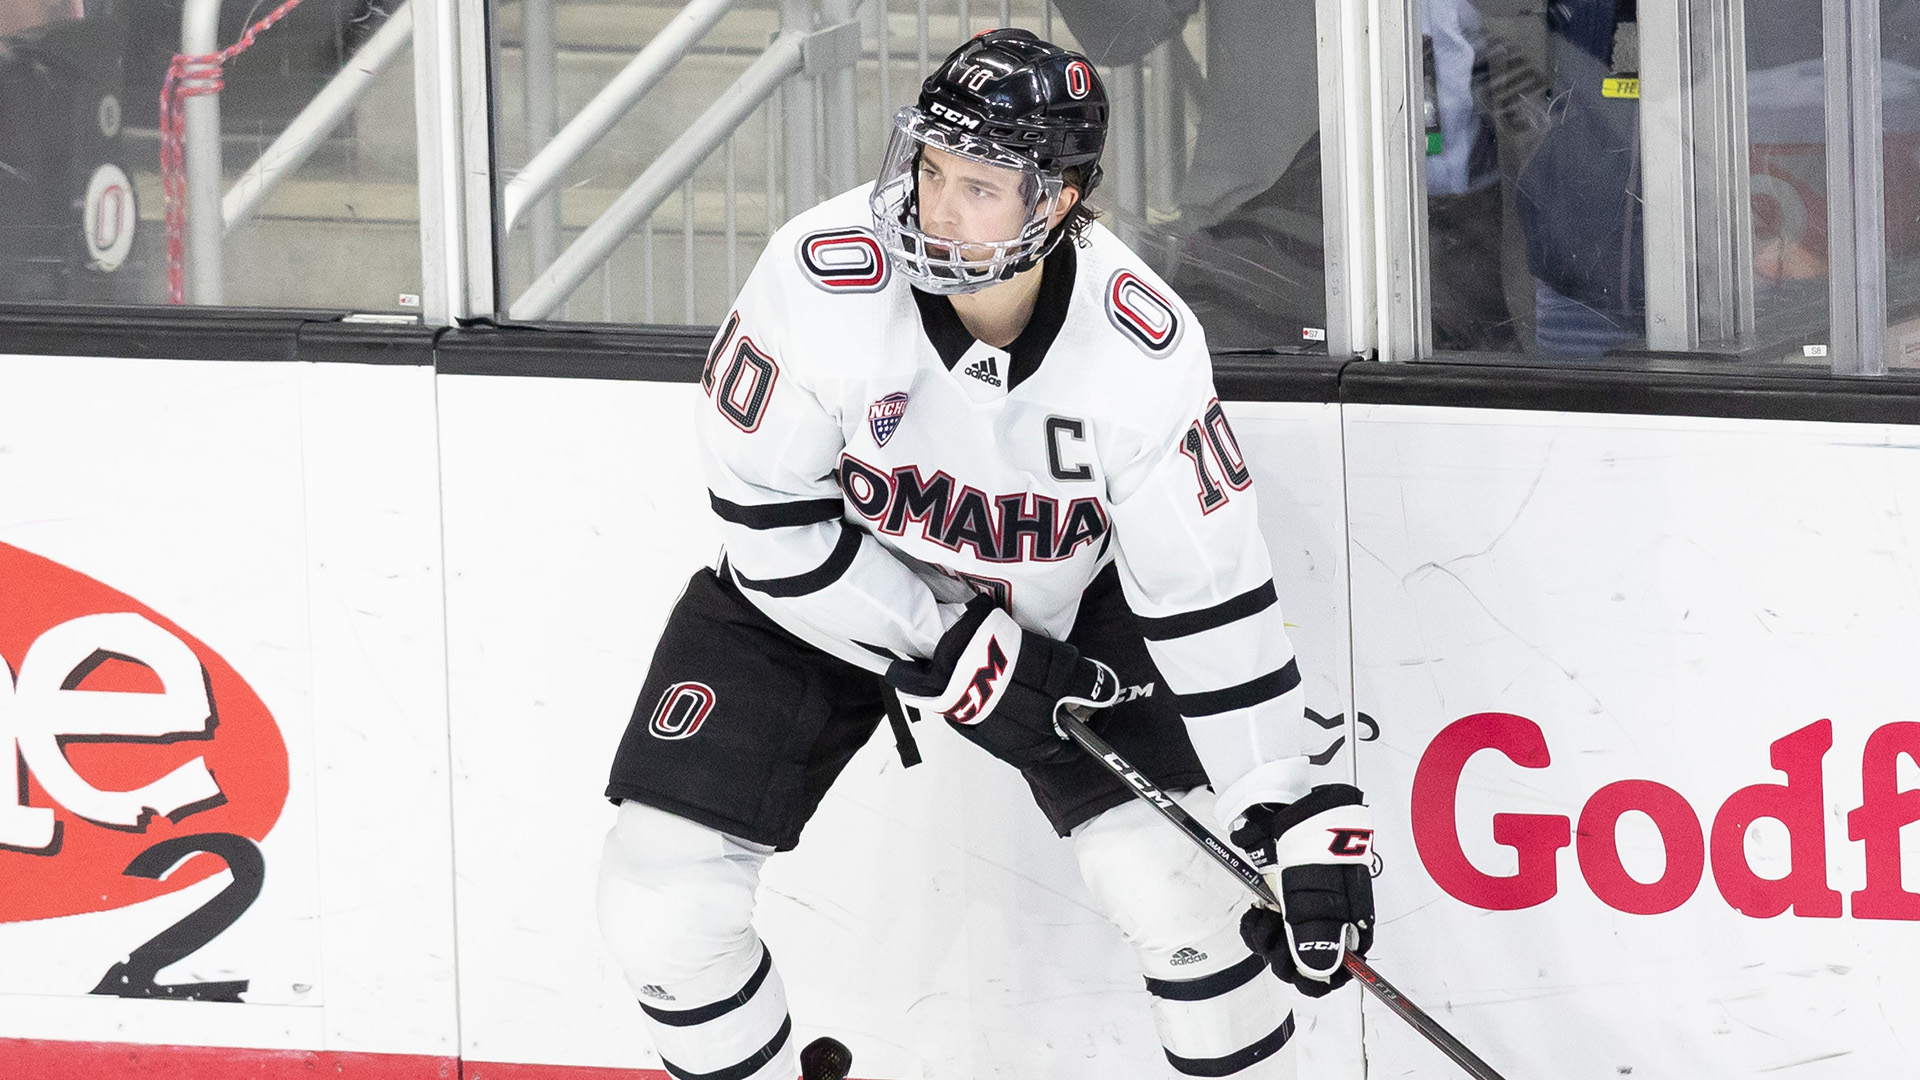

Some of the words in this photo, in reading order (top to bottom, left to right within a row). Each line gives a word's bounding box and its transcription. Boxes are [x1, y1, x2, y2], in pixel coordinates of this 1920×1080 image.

[930, 101, 980, 129] CCM
[701, 310, 780, 434] 10
[964, 364, 1002, 388] adidas
[1044, 414, 1096, 483] C
[1179, 397, 1253, 516] 10
[839, 452, 1108, 563] OMAHA
[1103, 752, 1174, 809] CCM
[1204, 836, 1231, 861] OMAHA
[1229, 857, 1240, 868] 10
[87, 832, 266, 1004] 2
[1298, 941, 1340, 951] CCM
[1169, 952, 1208, 966] adidas
